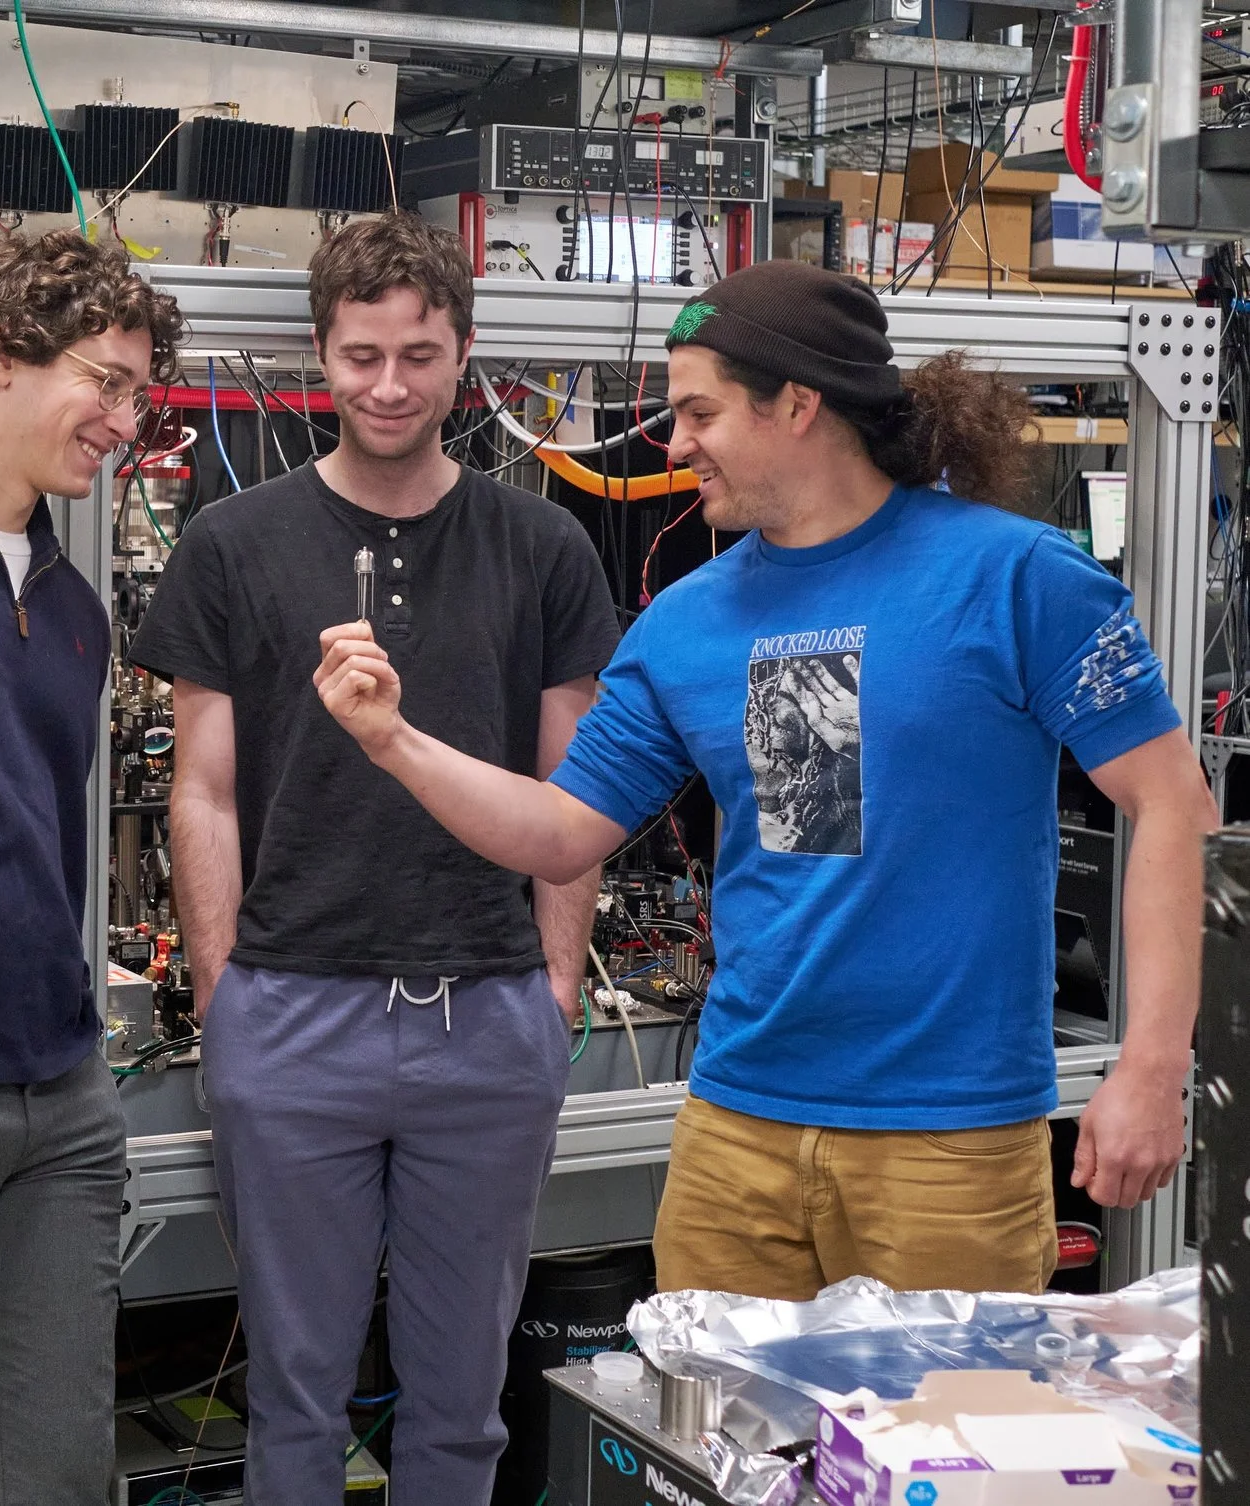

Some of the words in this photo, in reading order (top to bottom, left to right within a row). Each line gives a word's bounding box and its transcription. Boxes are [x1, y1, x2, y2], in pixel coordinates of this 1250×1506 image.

[750, 631, 818, 658] KNOCKED
[818, 625, 867, 651] LOOSE
[639, 901, 648, 919] SRS
[567, 1322, 627, 1339] Newpo
[1076, 1473, 1102, 1484] Large
